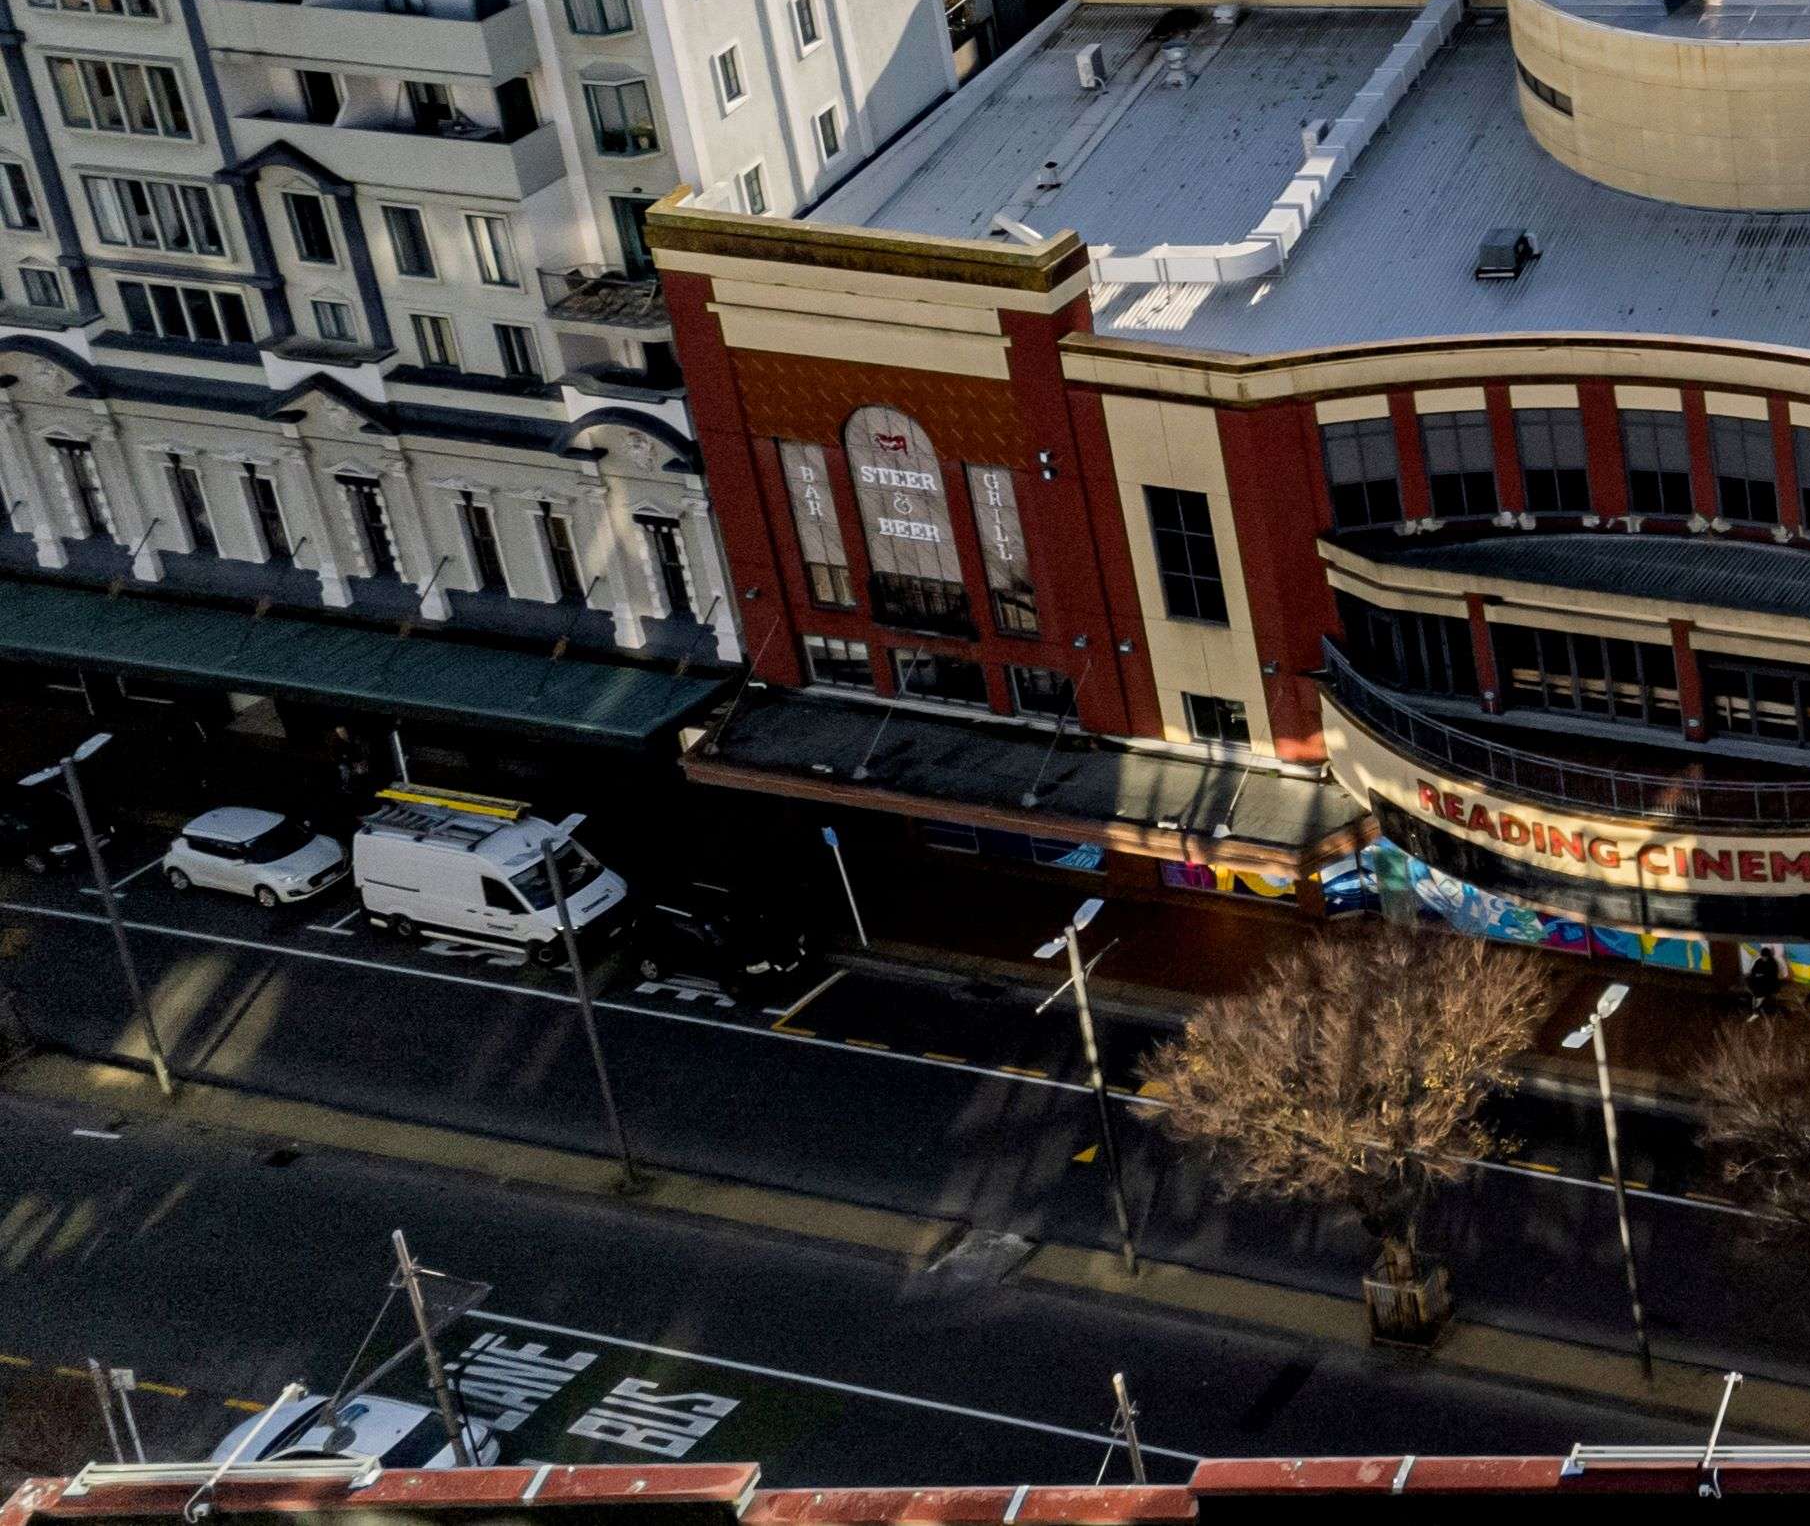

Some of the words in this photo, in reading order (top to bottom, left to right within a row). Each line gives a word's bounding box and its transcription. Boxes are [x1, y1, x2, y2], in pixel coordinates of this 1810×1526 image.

[799, 465, 823, 517] BAR
[860, 466, 937, 491] STEER
[893, 491, 912, 514] &
[878, 517, 941, 543] BEER
[984, 473, 1013, 560] GRILL
[1416, 778, 1621, 870] READING
[428, 1332, 598, 1431] LANE
[566, 1376, 741, 1458] BUS
